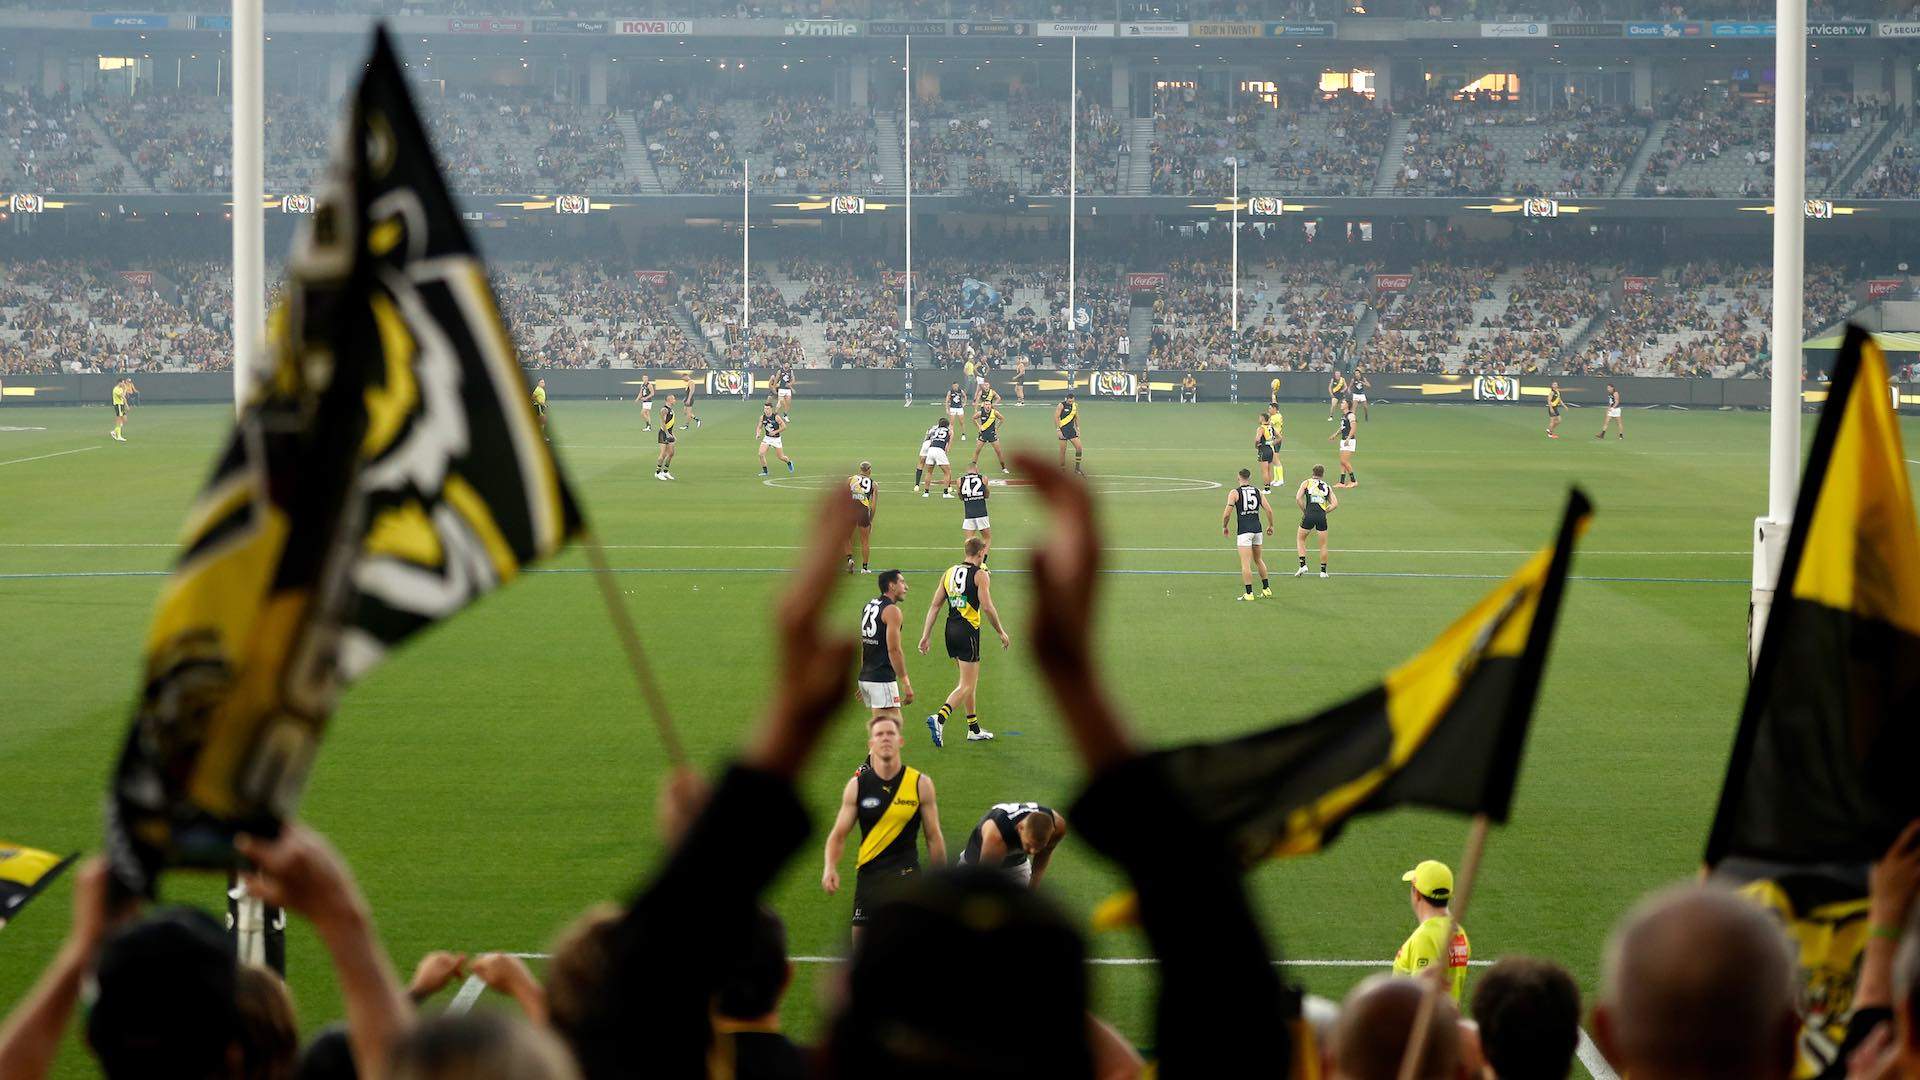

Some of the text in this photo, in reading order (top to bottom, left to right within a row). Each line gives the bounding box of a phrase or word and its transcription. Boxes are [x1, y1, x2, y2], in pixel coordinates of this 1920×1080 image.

[1054, 23, 1098, 32] Convergint
[1227, 25, 1256, 35] TWENTY
[1804, 24, 1866, 35] ervicenow
[961, 477, 984, 498] 42
[1242, 490, 1258, 511] 15
[949, 567, 968, 594] 19
[862, 603, 880, 638] 23
[894, 798, 918, 807] Jeep
